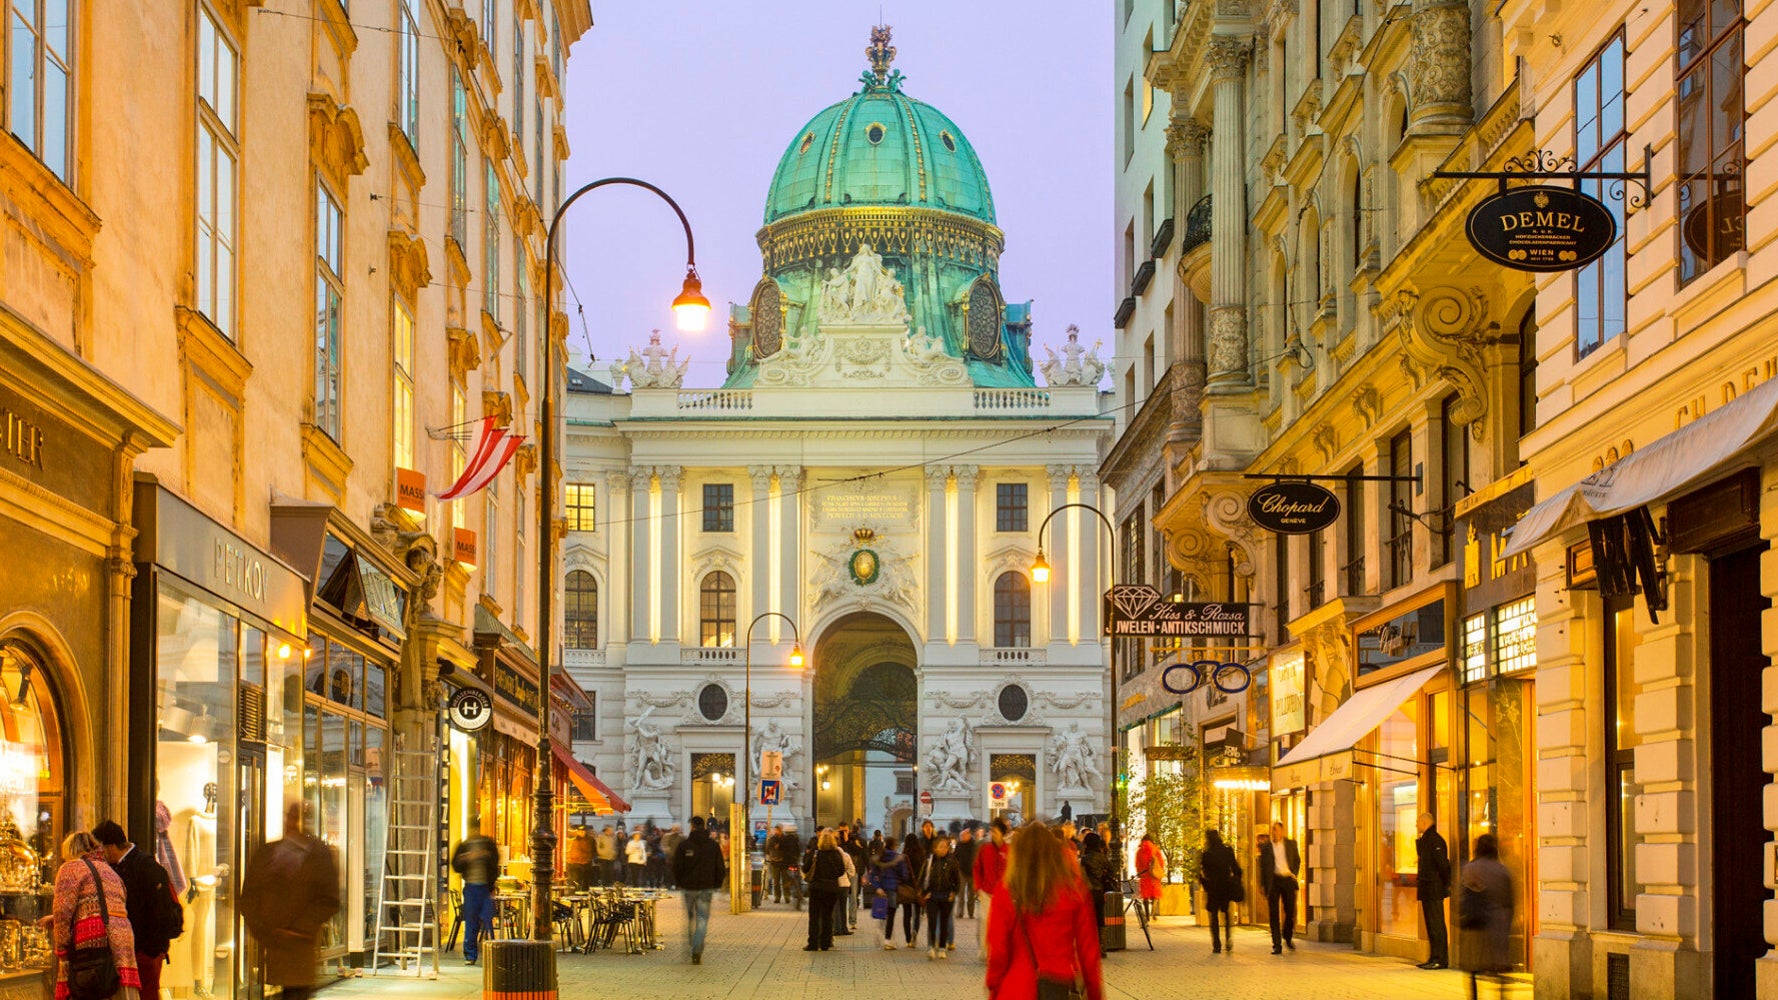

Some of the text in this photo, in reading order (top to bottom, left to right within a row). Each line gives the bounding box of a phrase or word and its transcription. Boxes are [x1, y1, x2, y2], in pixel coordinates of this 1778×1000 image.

[1500, 211, 1585, 232] DEMEL
[1257, 493, 1330, 517] Chopard
[214, 538, 269, 604] PETKOV
[1149, 603, 1181, 620] Kiss
[1185, 609, 1196, 619] &
[1160, 621, 1245, 635] ANTIKSCHMUCK
[461, 702, 479, 716] H
